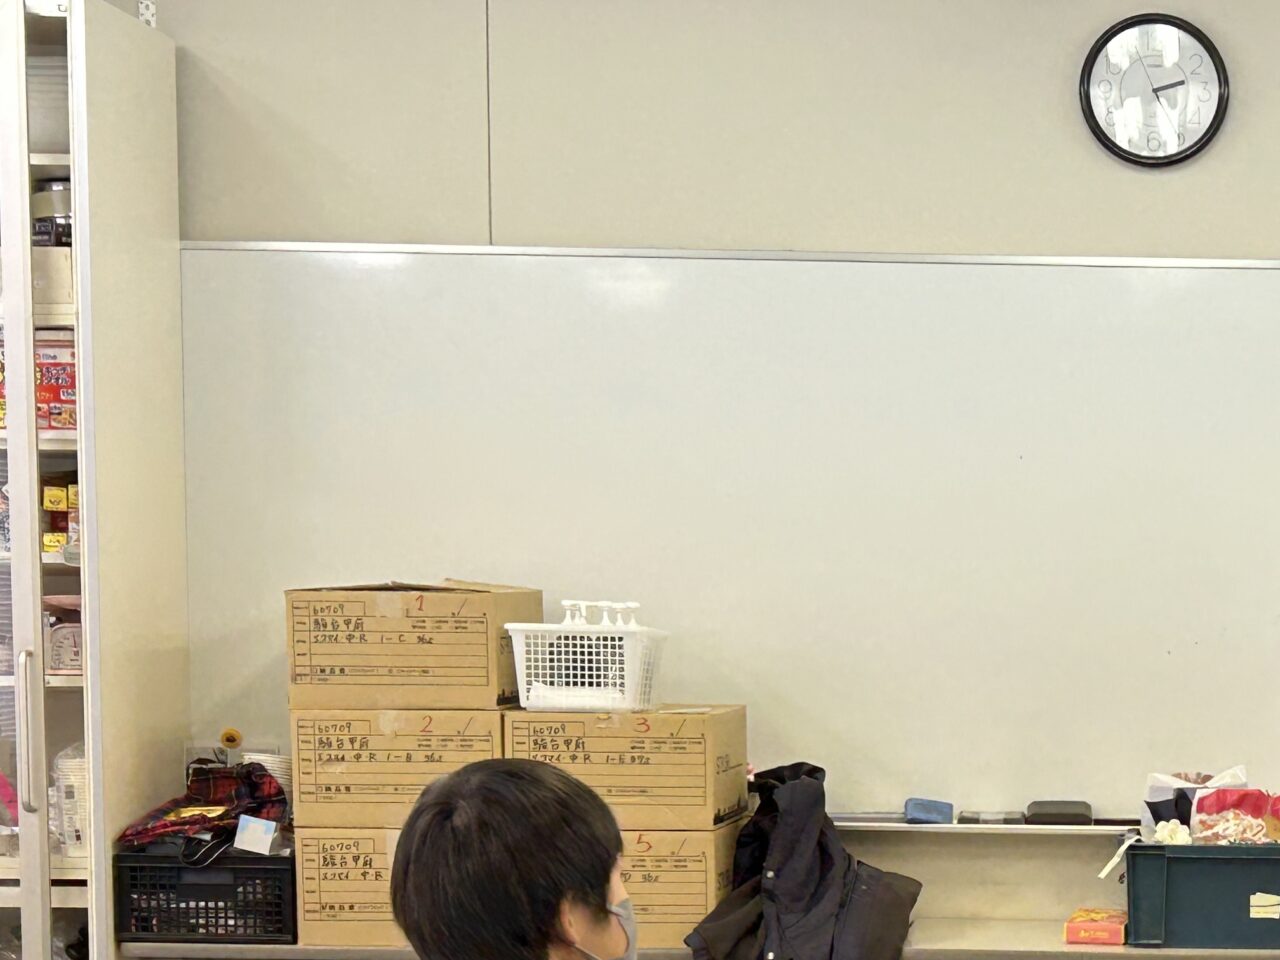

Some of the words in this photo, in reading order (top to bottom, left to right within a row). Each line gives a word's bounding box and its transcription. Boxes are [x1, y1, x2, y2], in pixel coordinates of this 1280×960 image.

[1189, 54, 1204, 76] 2
[1198, 81, 1212, 103] 3
[1187, 106, 1201, 125] 4
[1147, 131, 1161, 152] 6
[415, 595, 425, 611] 1
[419, 716, 433, 733] 2
[634, 717, 651, 733] 3
[322, 841, 360, 853] 60709
[635, 833, 653, 853] 5
